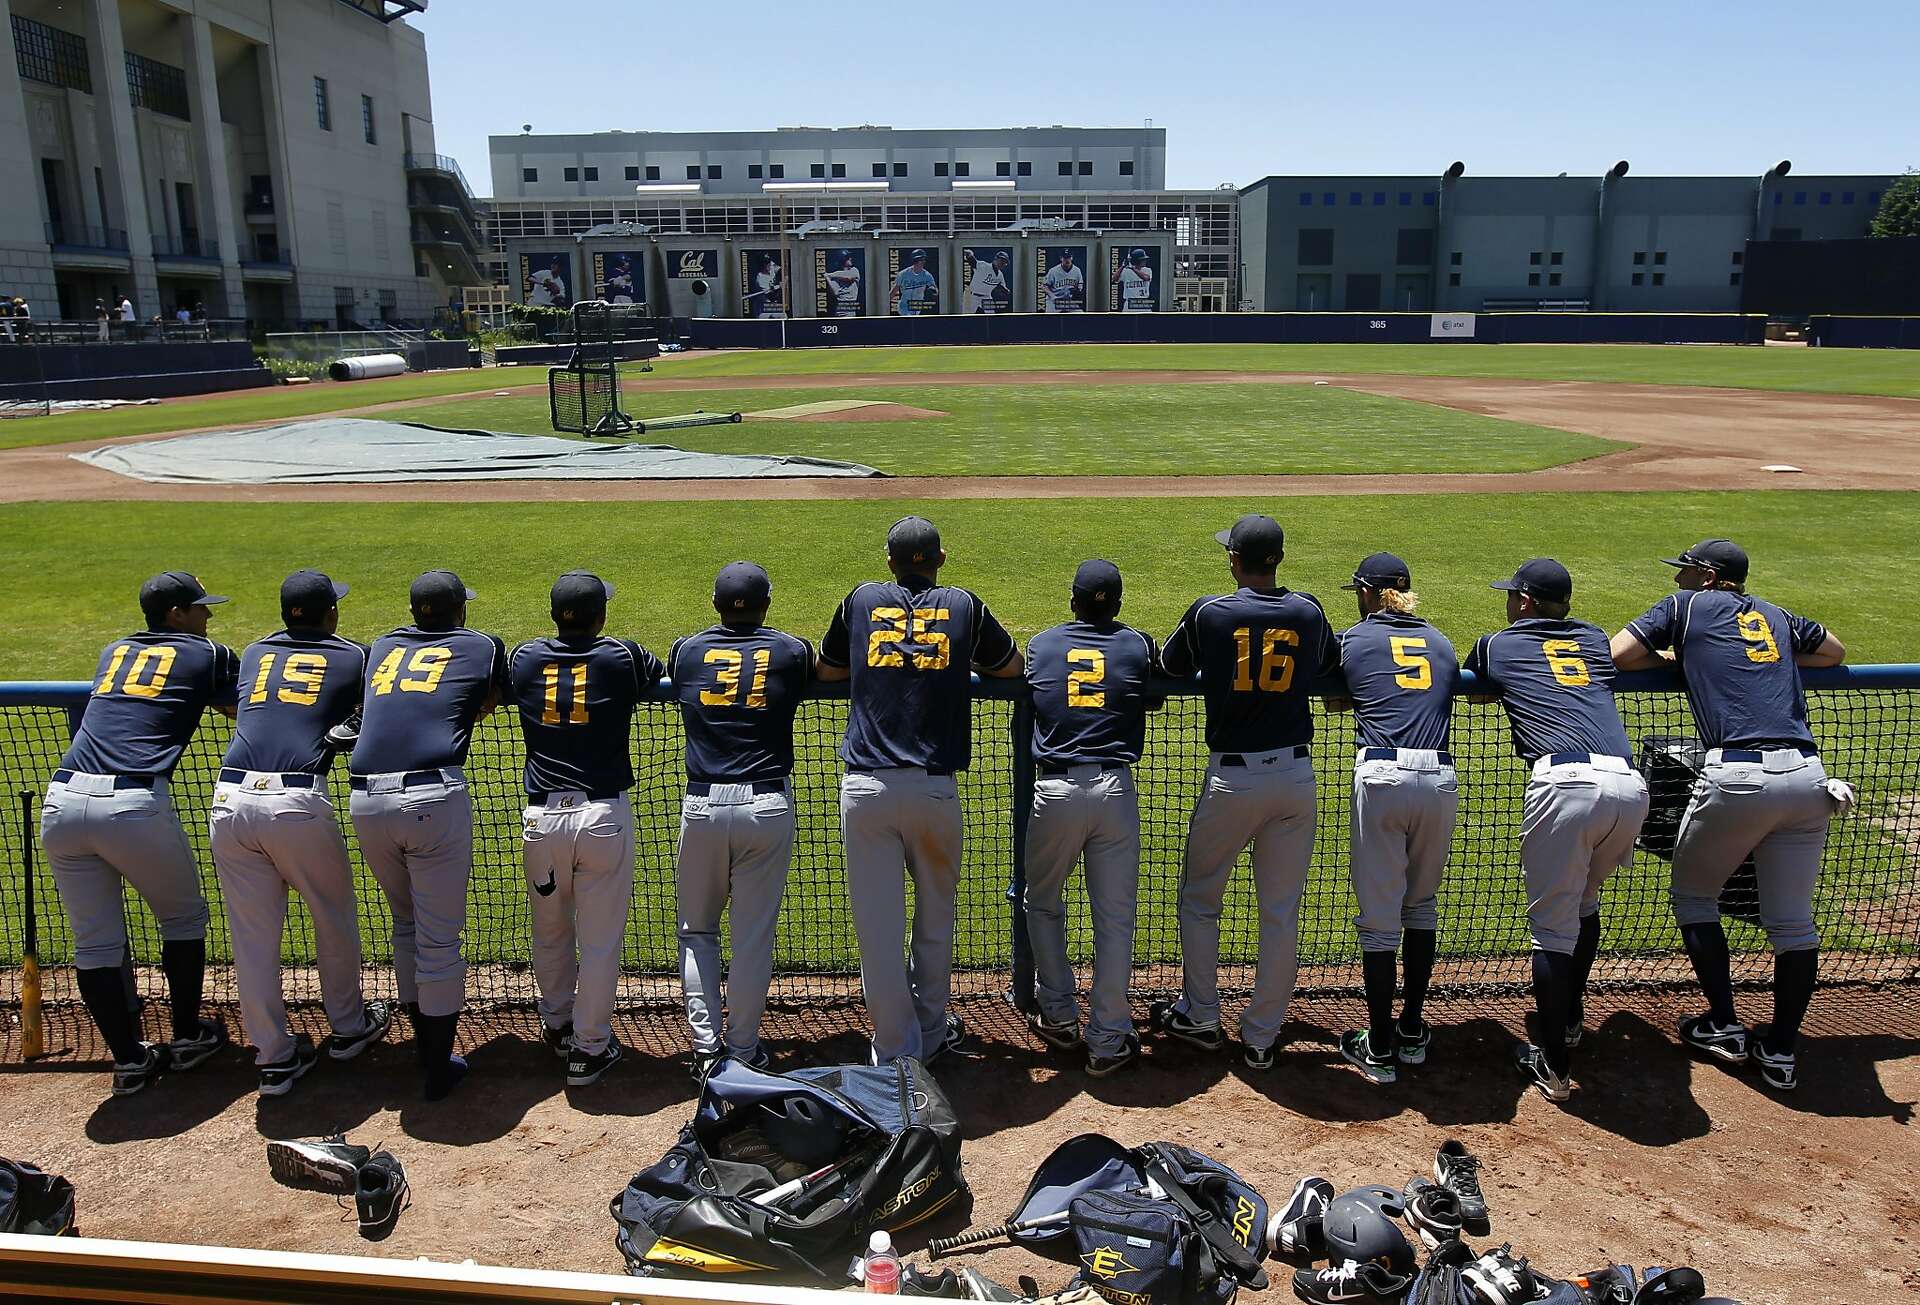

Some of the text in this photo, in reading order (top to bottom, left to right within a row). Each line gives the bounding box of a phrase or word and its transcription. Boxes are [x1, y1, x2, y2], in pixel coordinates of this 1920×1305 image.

[680, 251, 704, 272] Cal
[888, 249, 900, 278] LUKE
[1037, 248, 1045, 274] NADY
[1110, 248, 1118, 283] CKSON
[816, 292, 828, 313] JON
[821, 325, 838, 334] 320
[1369, 320, 1387, 329] 365
[867, 607, 951, 670] 25
[1737, 610, 1781, 663] 9
[96, 645, 177, 698] 10
[371, 647, 453, 697] 49
[1233, 627, 1297, 692] 16
[1388, 636, 1432, 690] 5
[1542, 639, 1591, 686] 6
[249, 653, 327, 706] 19
[541, 663, 589, 724] 11
[700, 649, 771, 709] 31
[1067, 649, 1105, 708] 2
[254, 778, 270, 791] Cal
[559, 796, 574, 809] Cal
[569, 1062, 586, 1072] NIKE
[1091, 1251, 1119, 1276] E
[1092, 1282, 1152, 1305] STON
